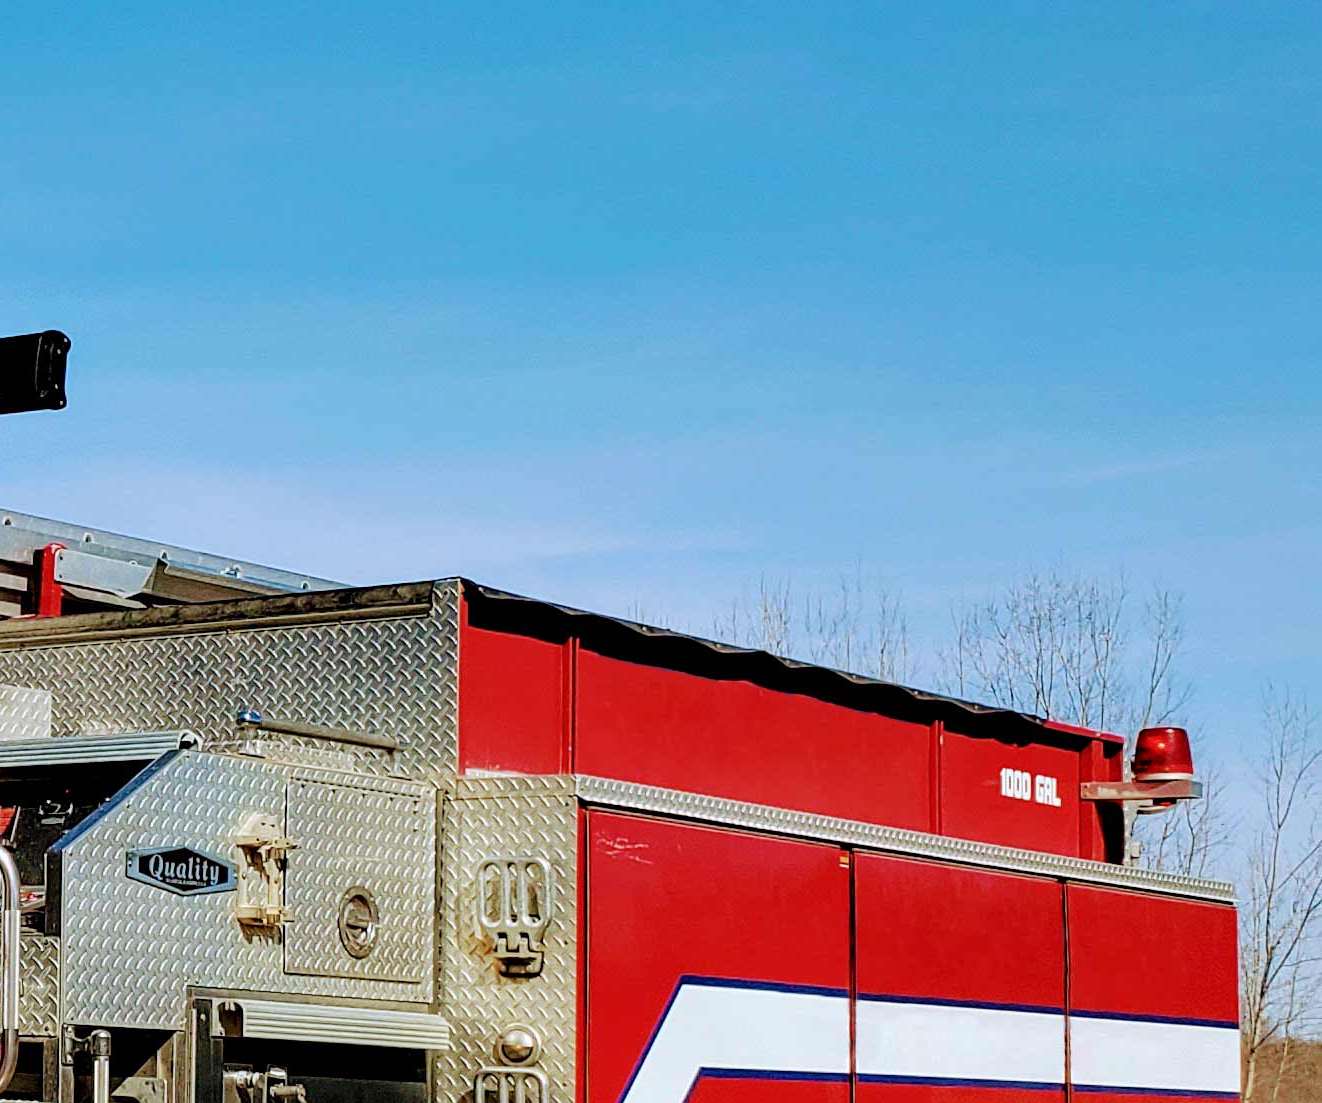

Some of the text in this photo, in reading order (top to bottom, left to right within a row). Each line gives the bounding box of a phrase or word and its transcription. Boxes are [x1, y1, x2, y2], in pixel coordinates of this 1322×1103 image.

[999, 767, 1062, 807] 1000 GAL
[148, 854, 220, 886] Quality
